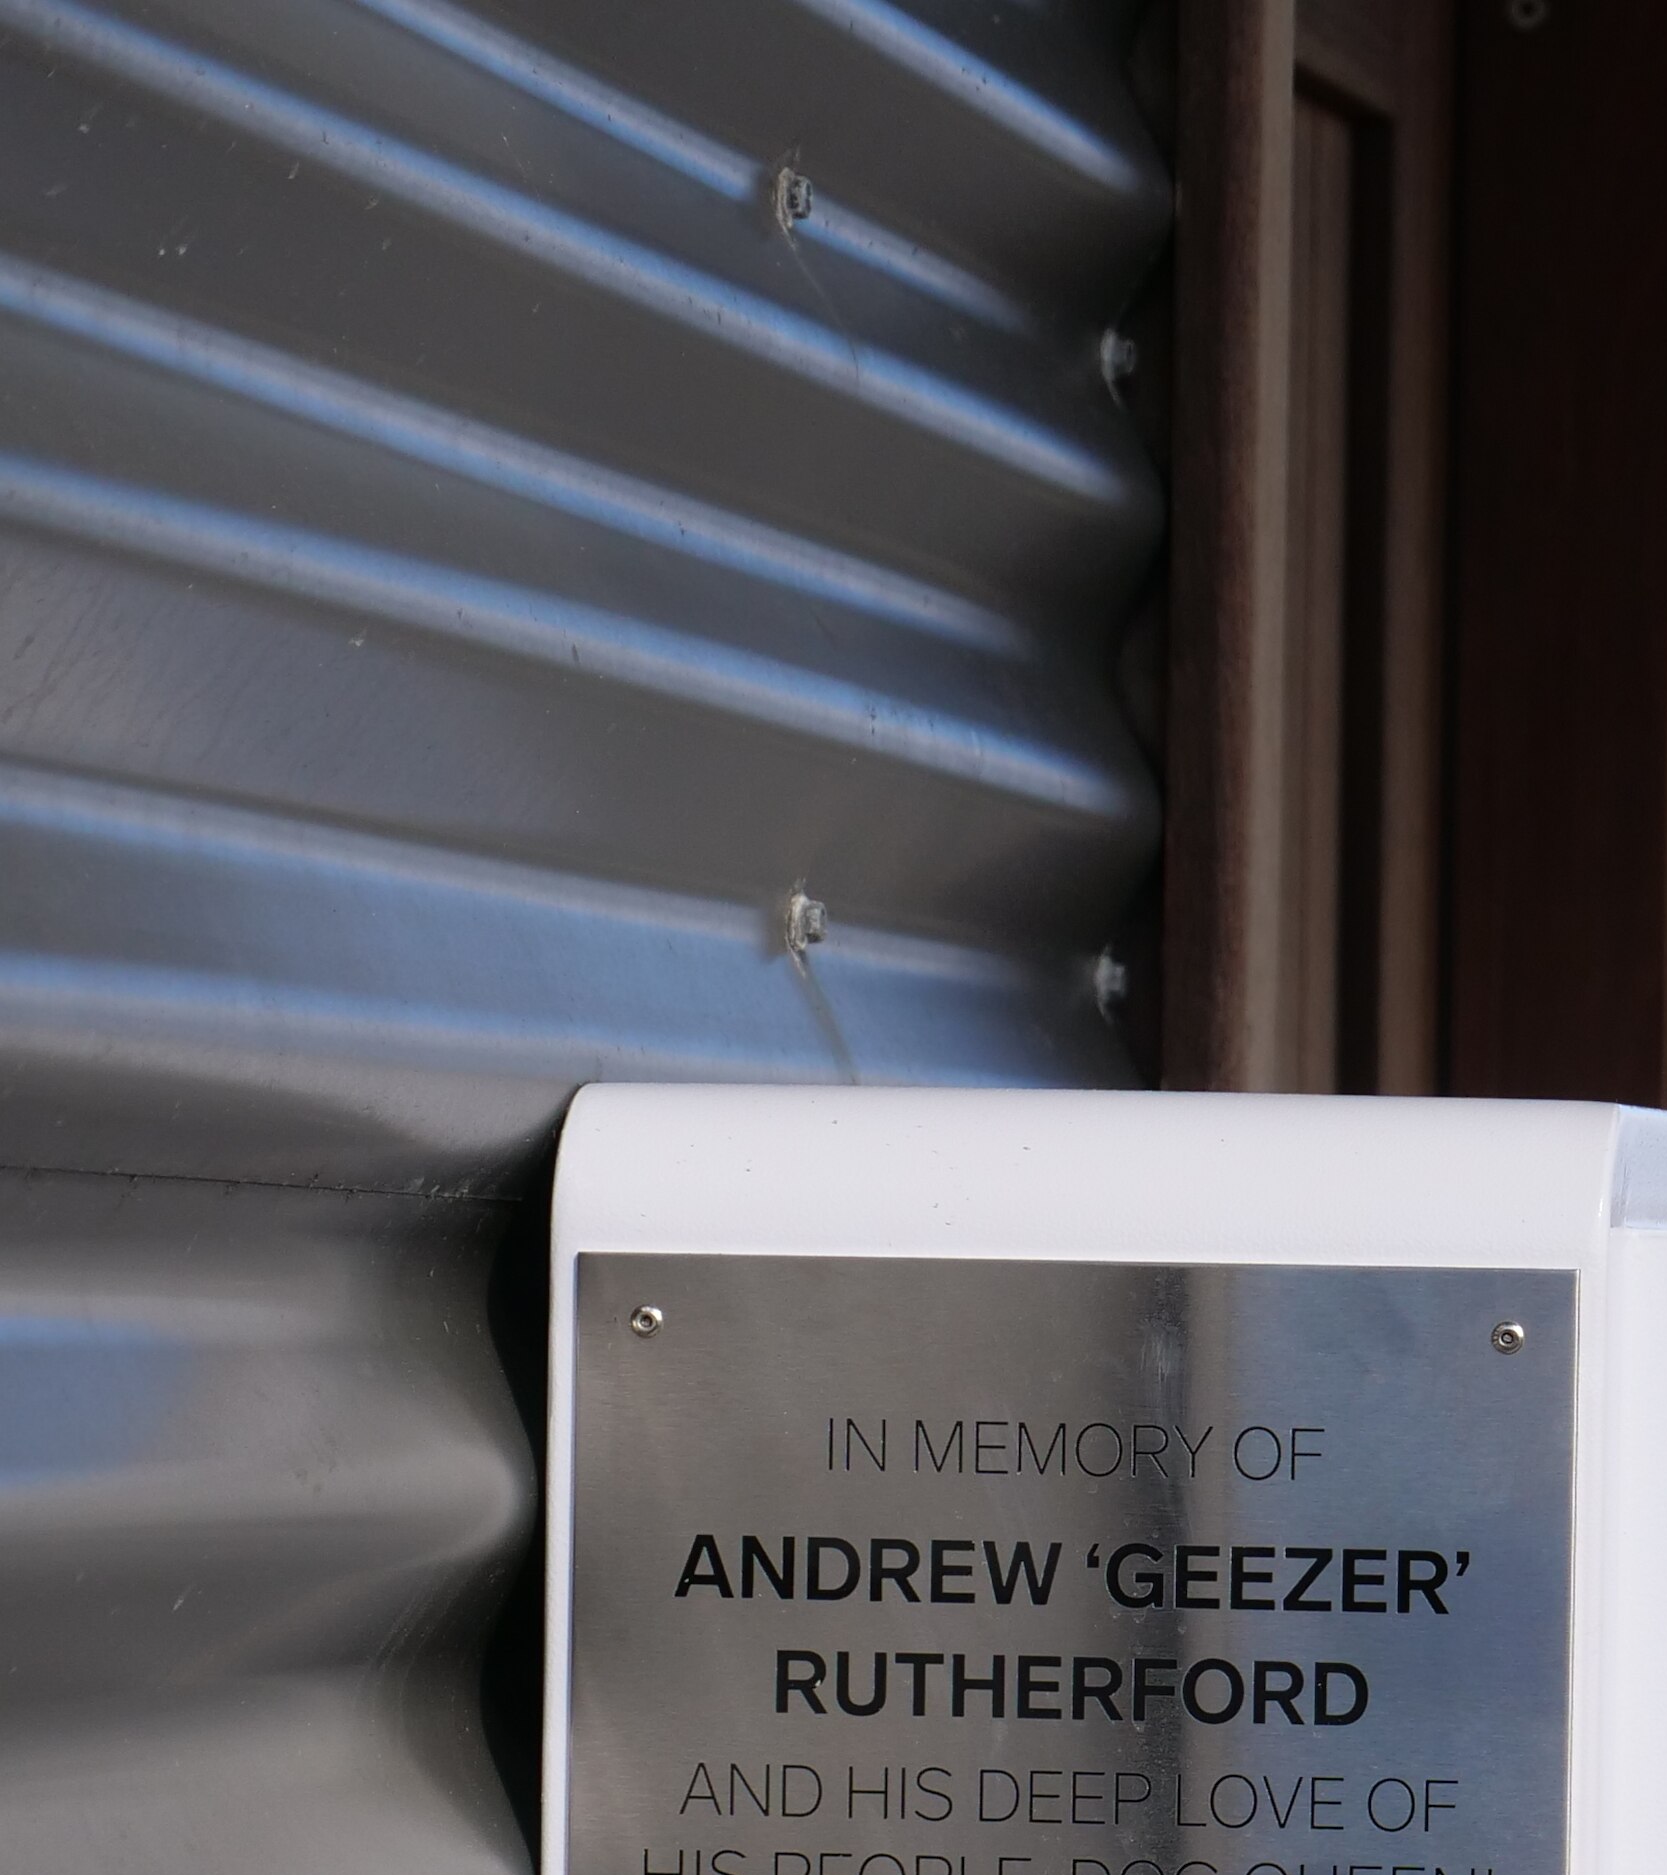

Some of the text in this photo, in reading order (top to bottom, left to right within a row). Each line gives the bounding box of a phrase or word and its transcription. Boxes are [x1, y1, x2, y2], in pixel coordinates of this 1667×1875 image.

[827, 1417, 1325, 1481] IN MEMORY OF
[673, 1534, 1063, 1605] ANDREW
[774, 1650, 1370, 1727] RUTHERFORD
[679, 1762, 1459, 1832] AND HIS DEEP LOVE OF
